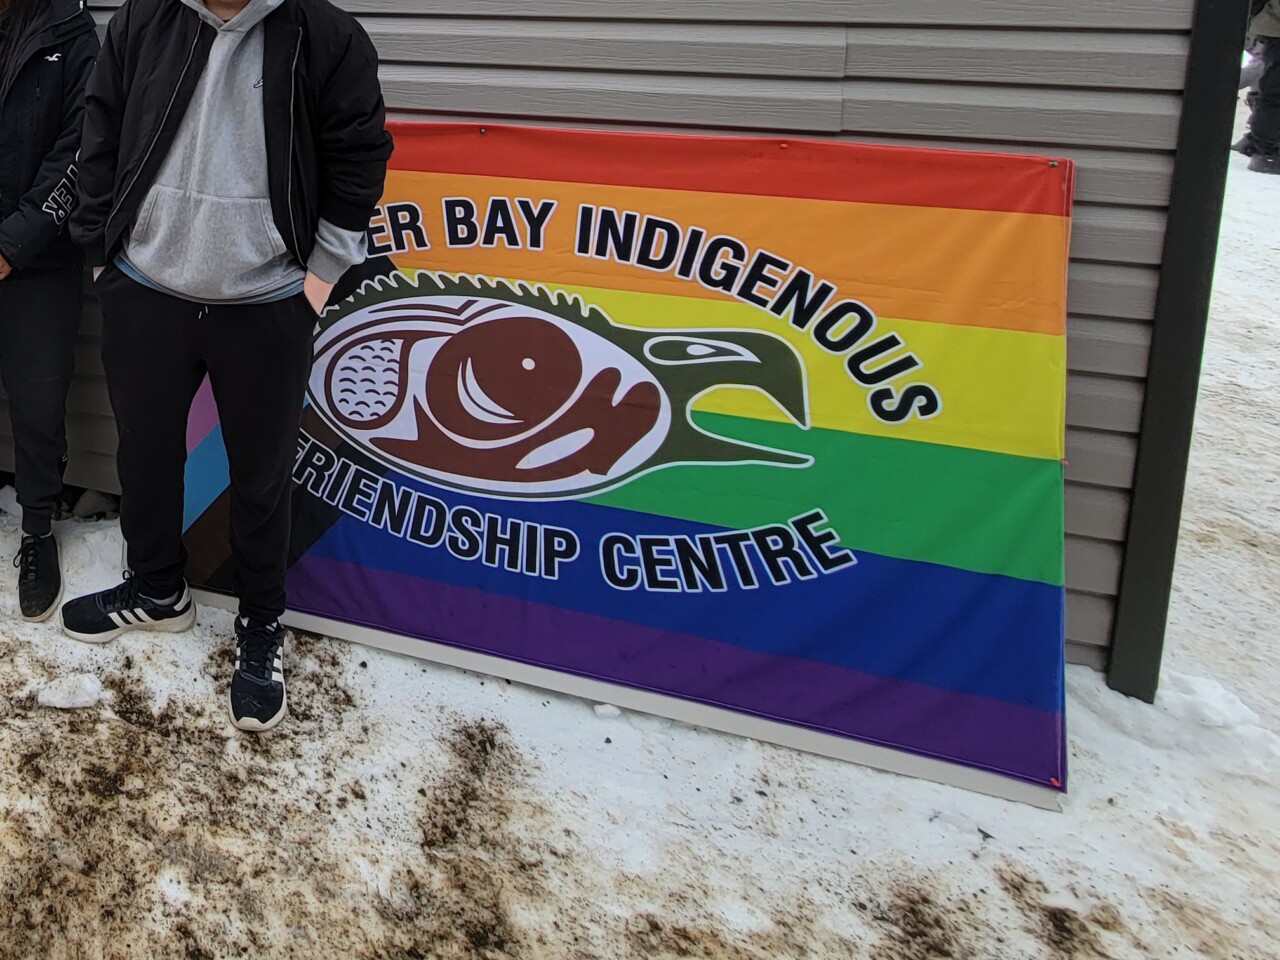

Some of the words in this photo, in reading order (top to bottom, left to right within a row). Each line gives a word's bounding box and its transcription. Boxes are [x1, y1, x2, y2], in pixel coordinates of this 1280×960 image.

[368, 201, 431, 258] ER
[442, 196, 558, 252] BAY
[574, 203, 942, 423] INDIGENOUS
[599, 507, 858, 593] CENTRE
